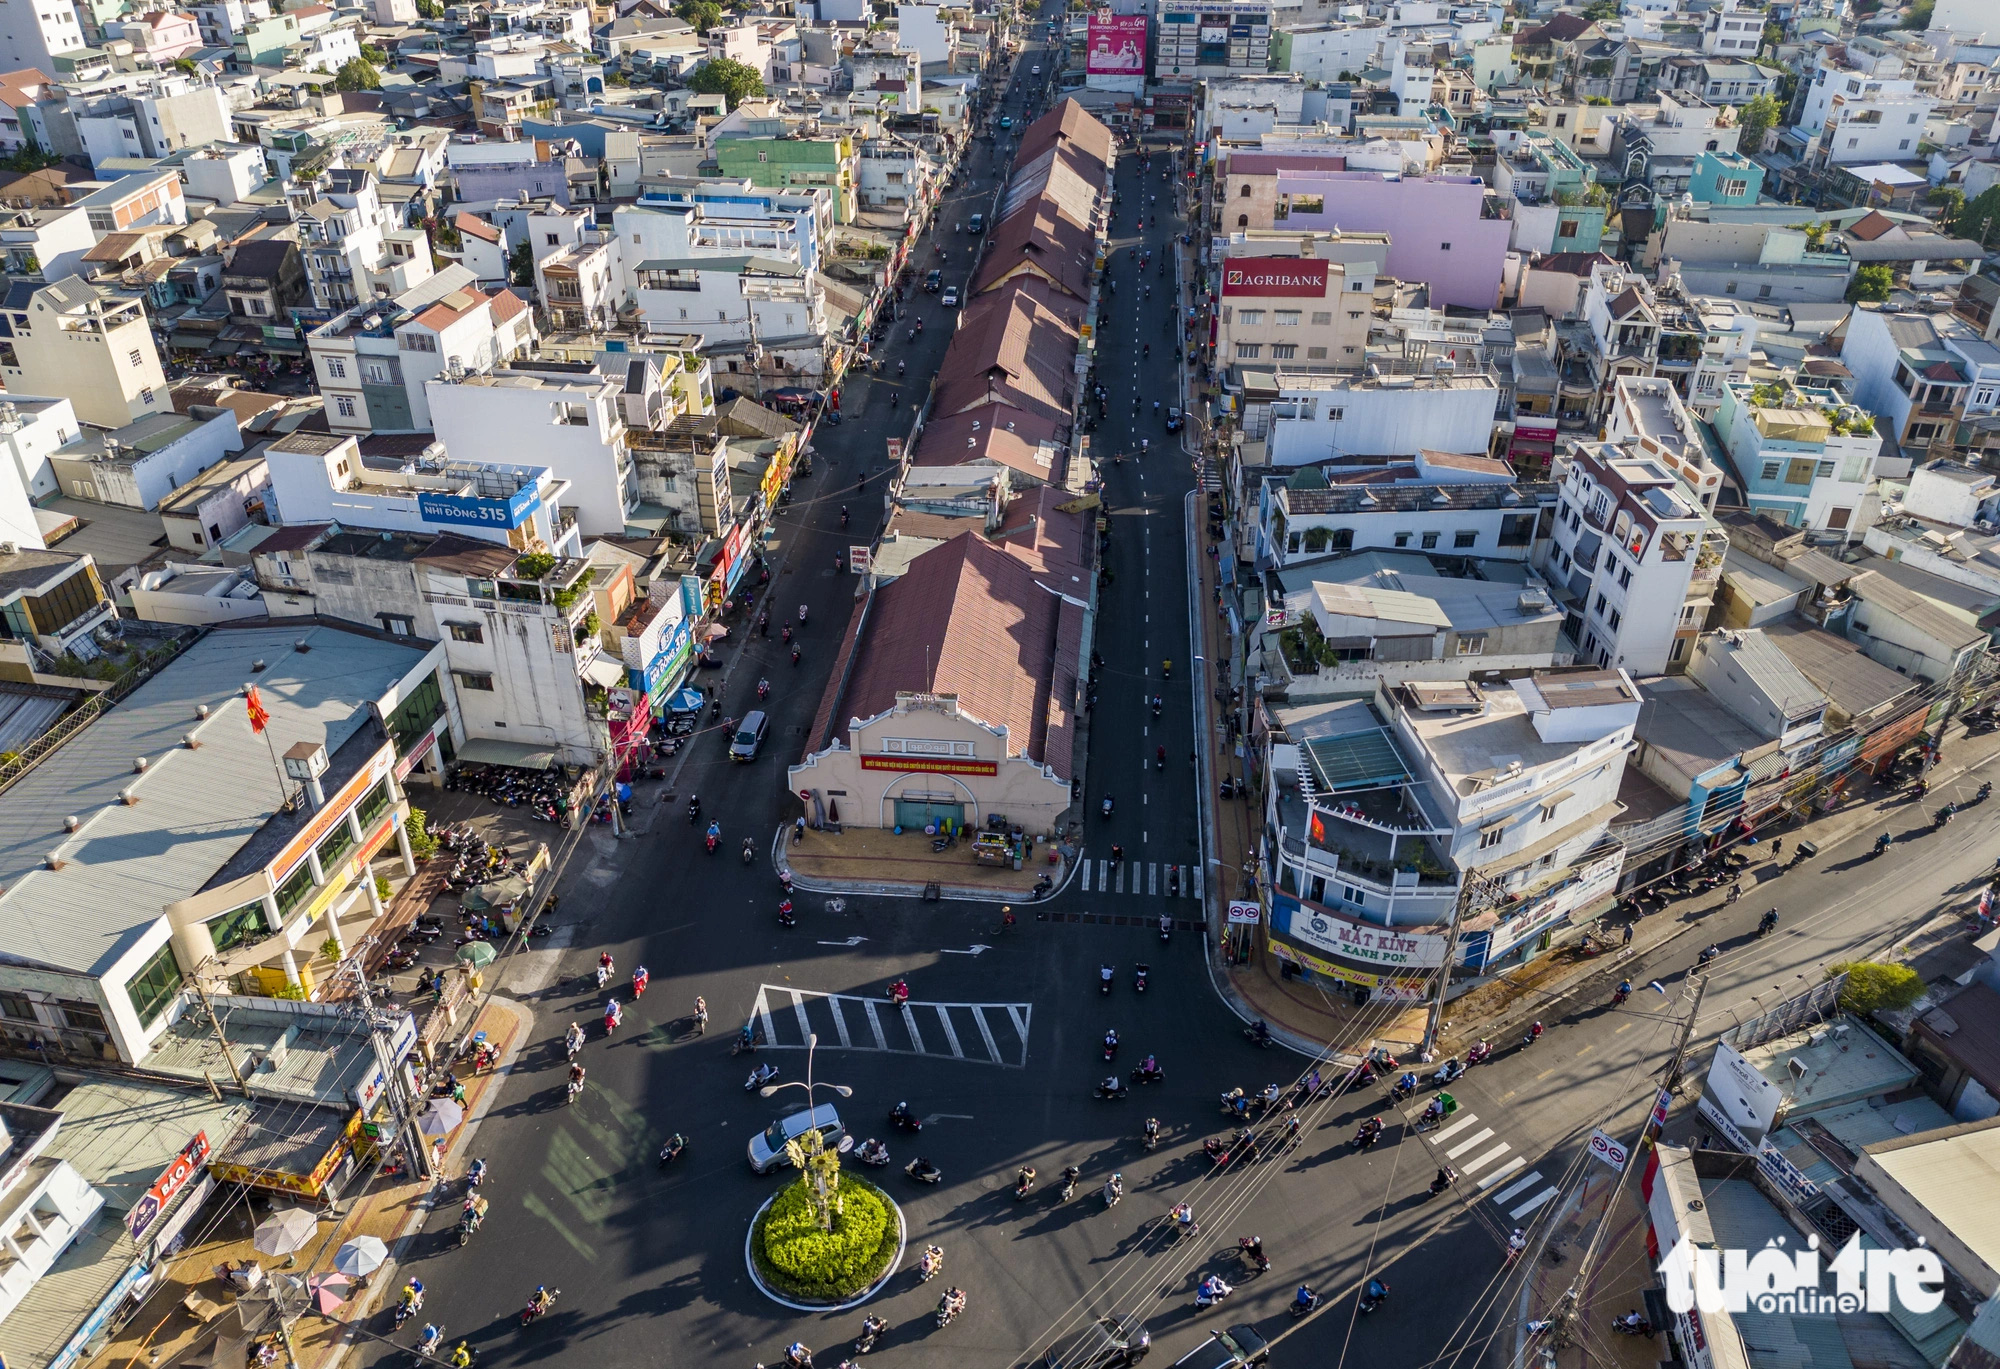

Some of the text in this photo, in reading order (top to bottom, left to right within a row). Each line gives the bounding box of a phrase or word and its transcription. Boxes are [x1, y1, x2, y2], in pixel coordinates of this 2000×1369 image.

[1244, 276, 1322, 286] AGRIBANK
[424, 503, 506, 521] NHI ĐỒNG 315
[1338, 926, 1418, 953] MẮT KÍNH
[1341, 943, 1408, 963] XANH PON
[1710, 1107, 1751, 1152] TÁO THỦ ĐỨC
[161, 1139, 207, 1197] BẢO YÊN
